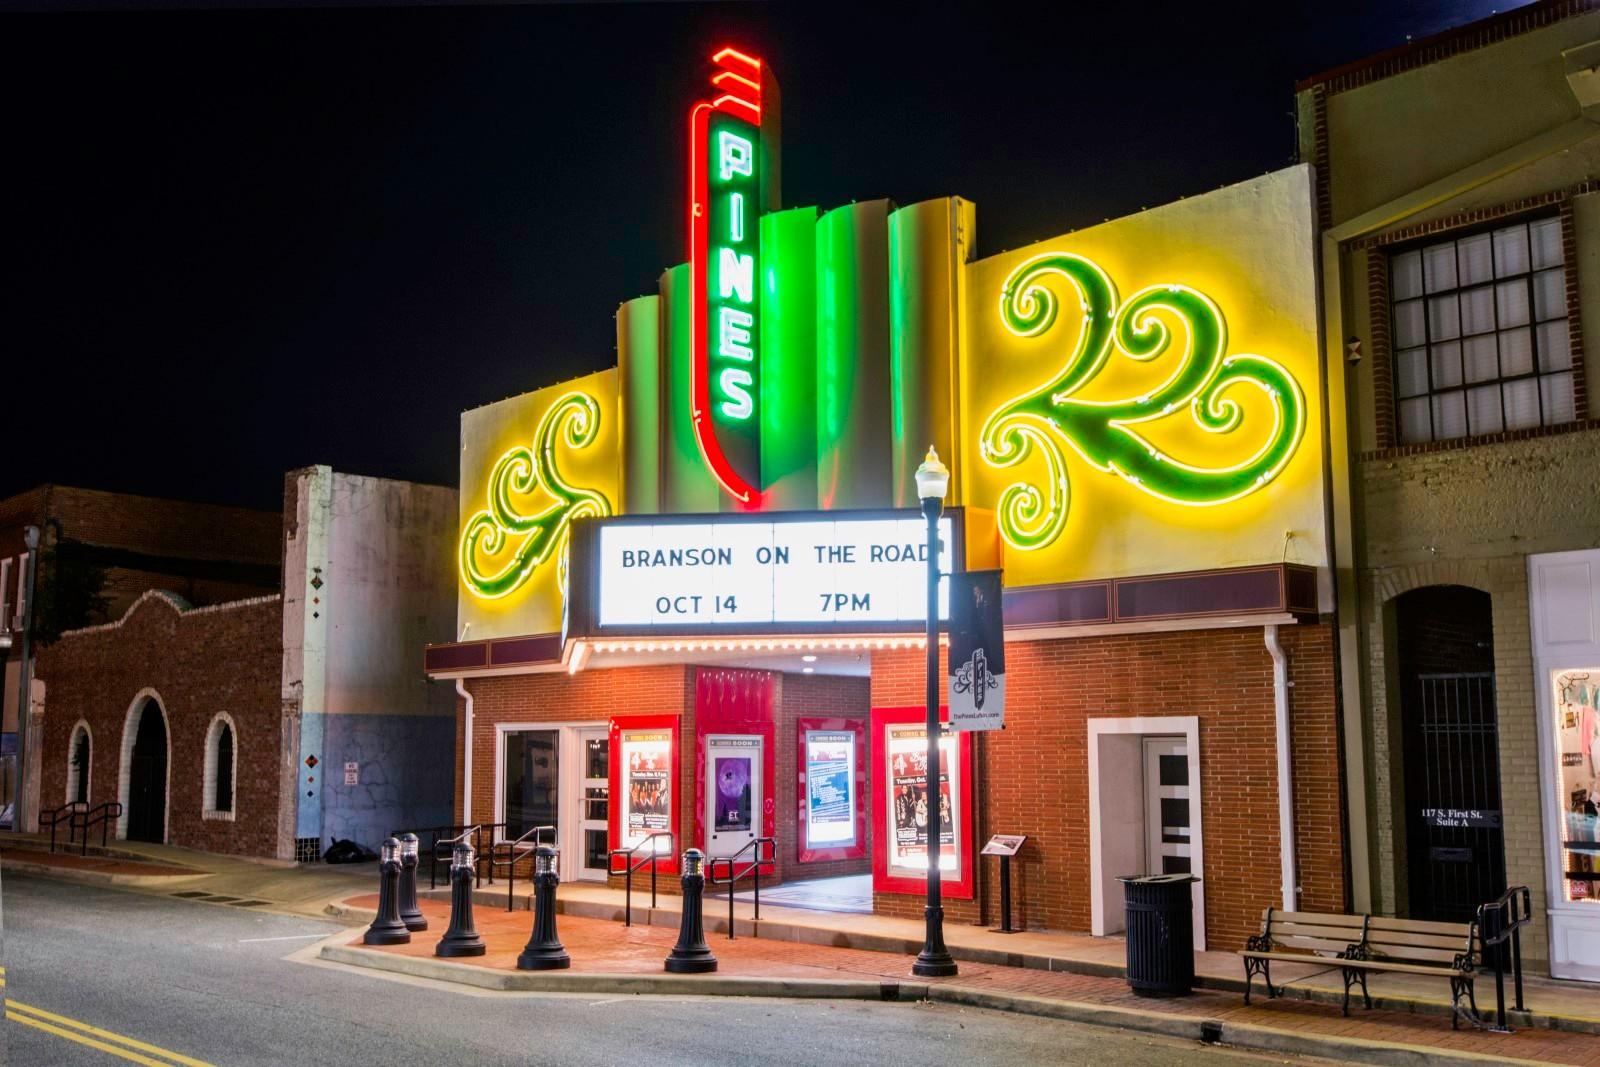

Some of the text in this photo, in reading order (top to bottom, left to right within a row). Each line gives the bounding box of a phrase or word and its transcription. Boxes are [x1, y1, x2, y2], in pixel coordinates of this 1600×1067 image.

[718, 130, 753, 420] PINES
[622, 547, 732, 568] BRANSON
[756, 546, 789, 565] ON
[813, 545, 856, 563] THE
[656, 592, 871, 614] OCT 14 7PM
[1421, 808, 1483, 819] 117 S. First St.
[1436, 817, 1469, 827] Suite A
